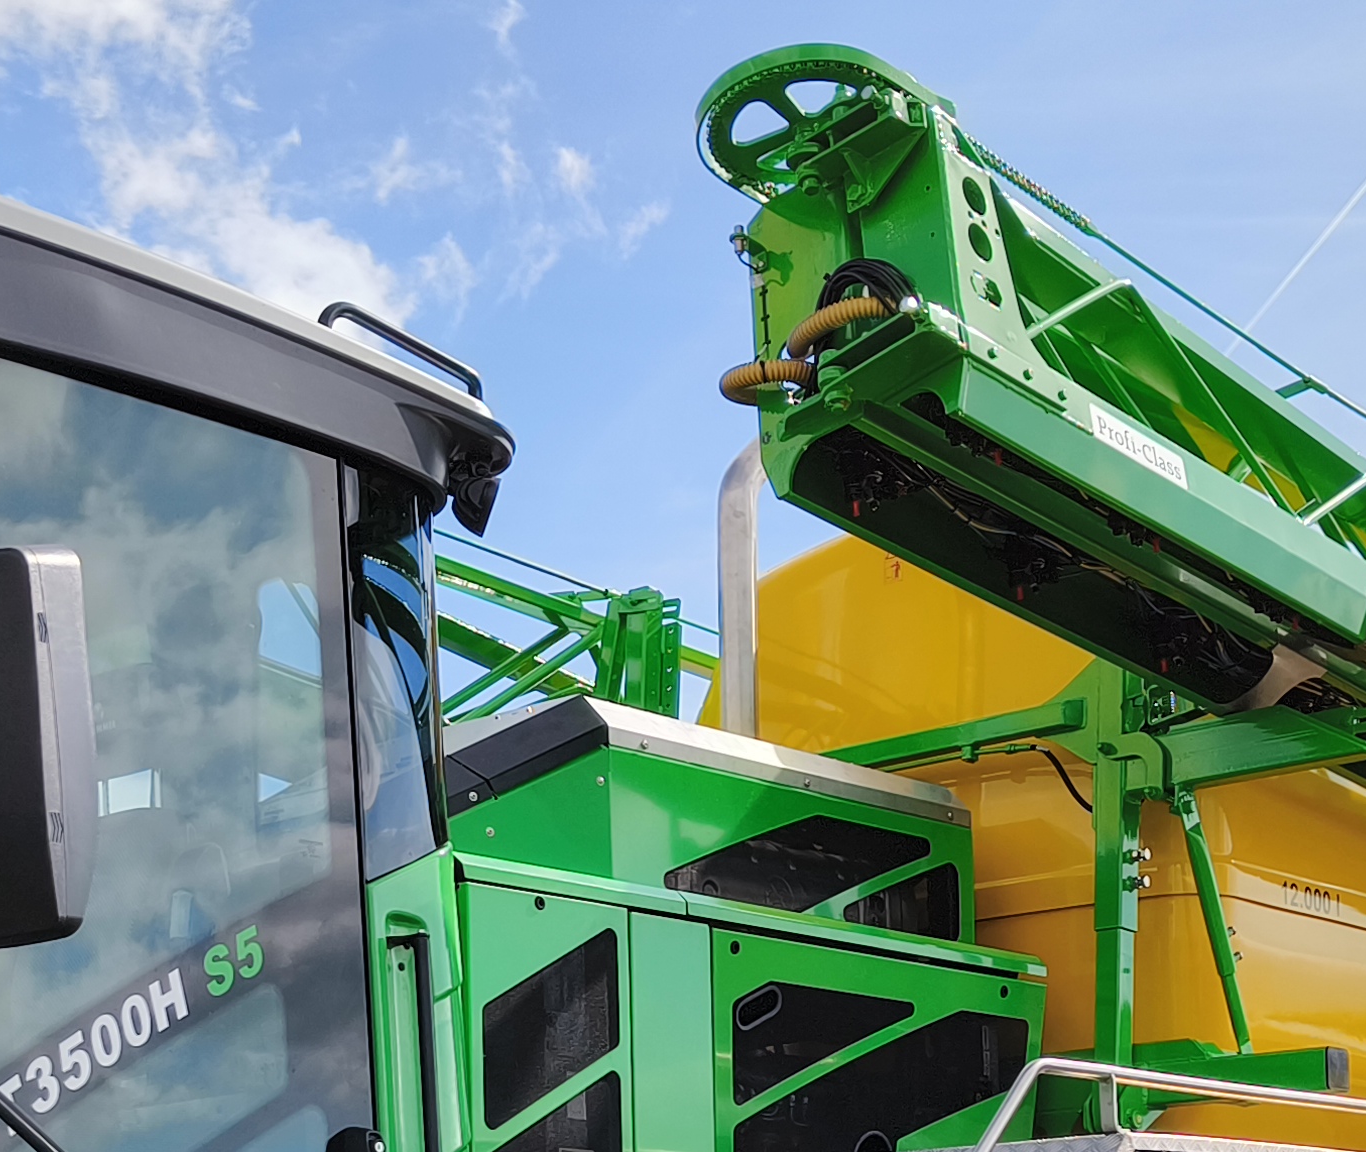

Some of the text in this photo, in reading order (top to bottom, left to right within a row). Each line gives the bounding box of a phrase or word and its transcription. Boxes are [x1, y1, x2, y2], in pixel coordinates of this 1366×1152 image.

[1096, 414, 1183, 481] Profi-Class
[1281, 880, 1331, 915] 12.000
[203, 924, 264, 997] S5
